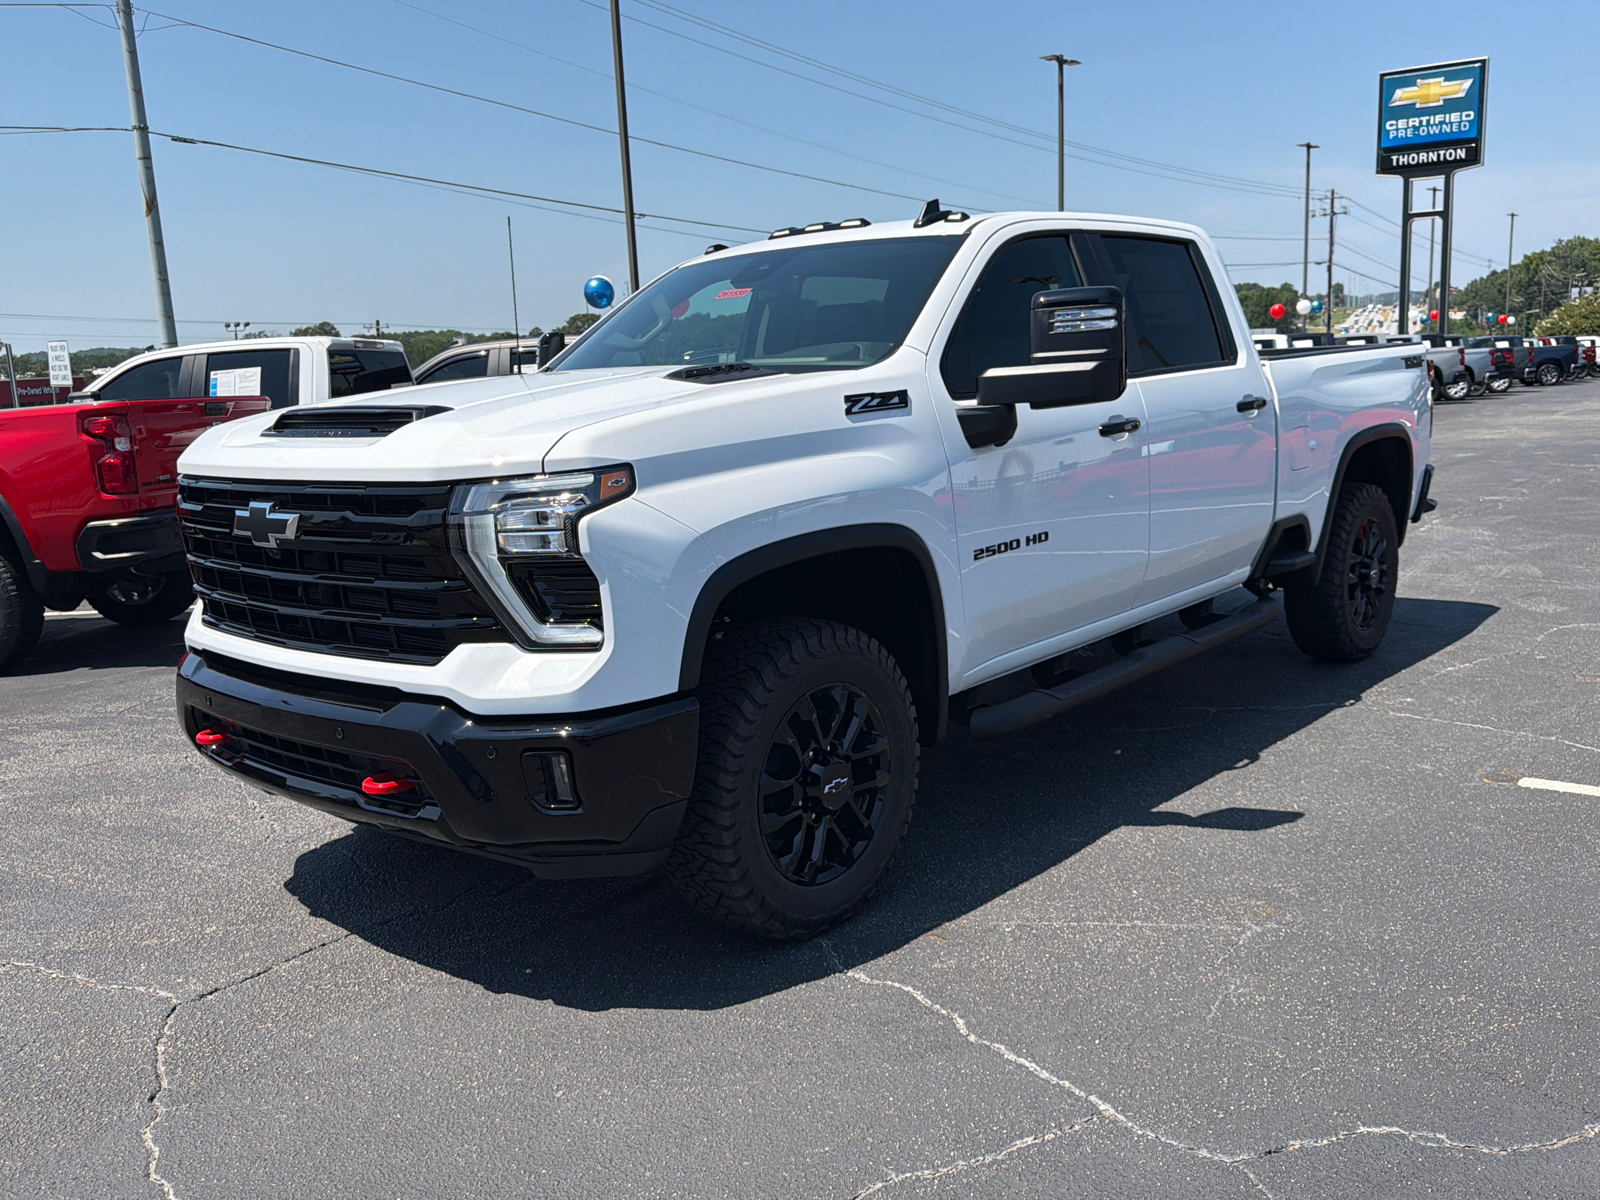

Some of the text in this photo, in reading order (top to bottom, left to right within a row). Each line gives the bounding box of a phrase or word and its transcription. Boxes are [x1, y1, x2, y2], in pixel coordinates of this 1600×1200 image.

[1385, 110, 1475, 130] CERTIFIED
[1389, 121, 1470, 139] PRE-OWNED
[1390, 148, 1466, 166] THORNTON
[973, 531, 1049, 561] 2500 HD
